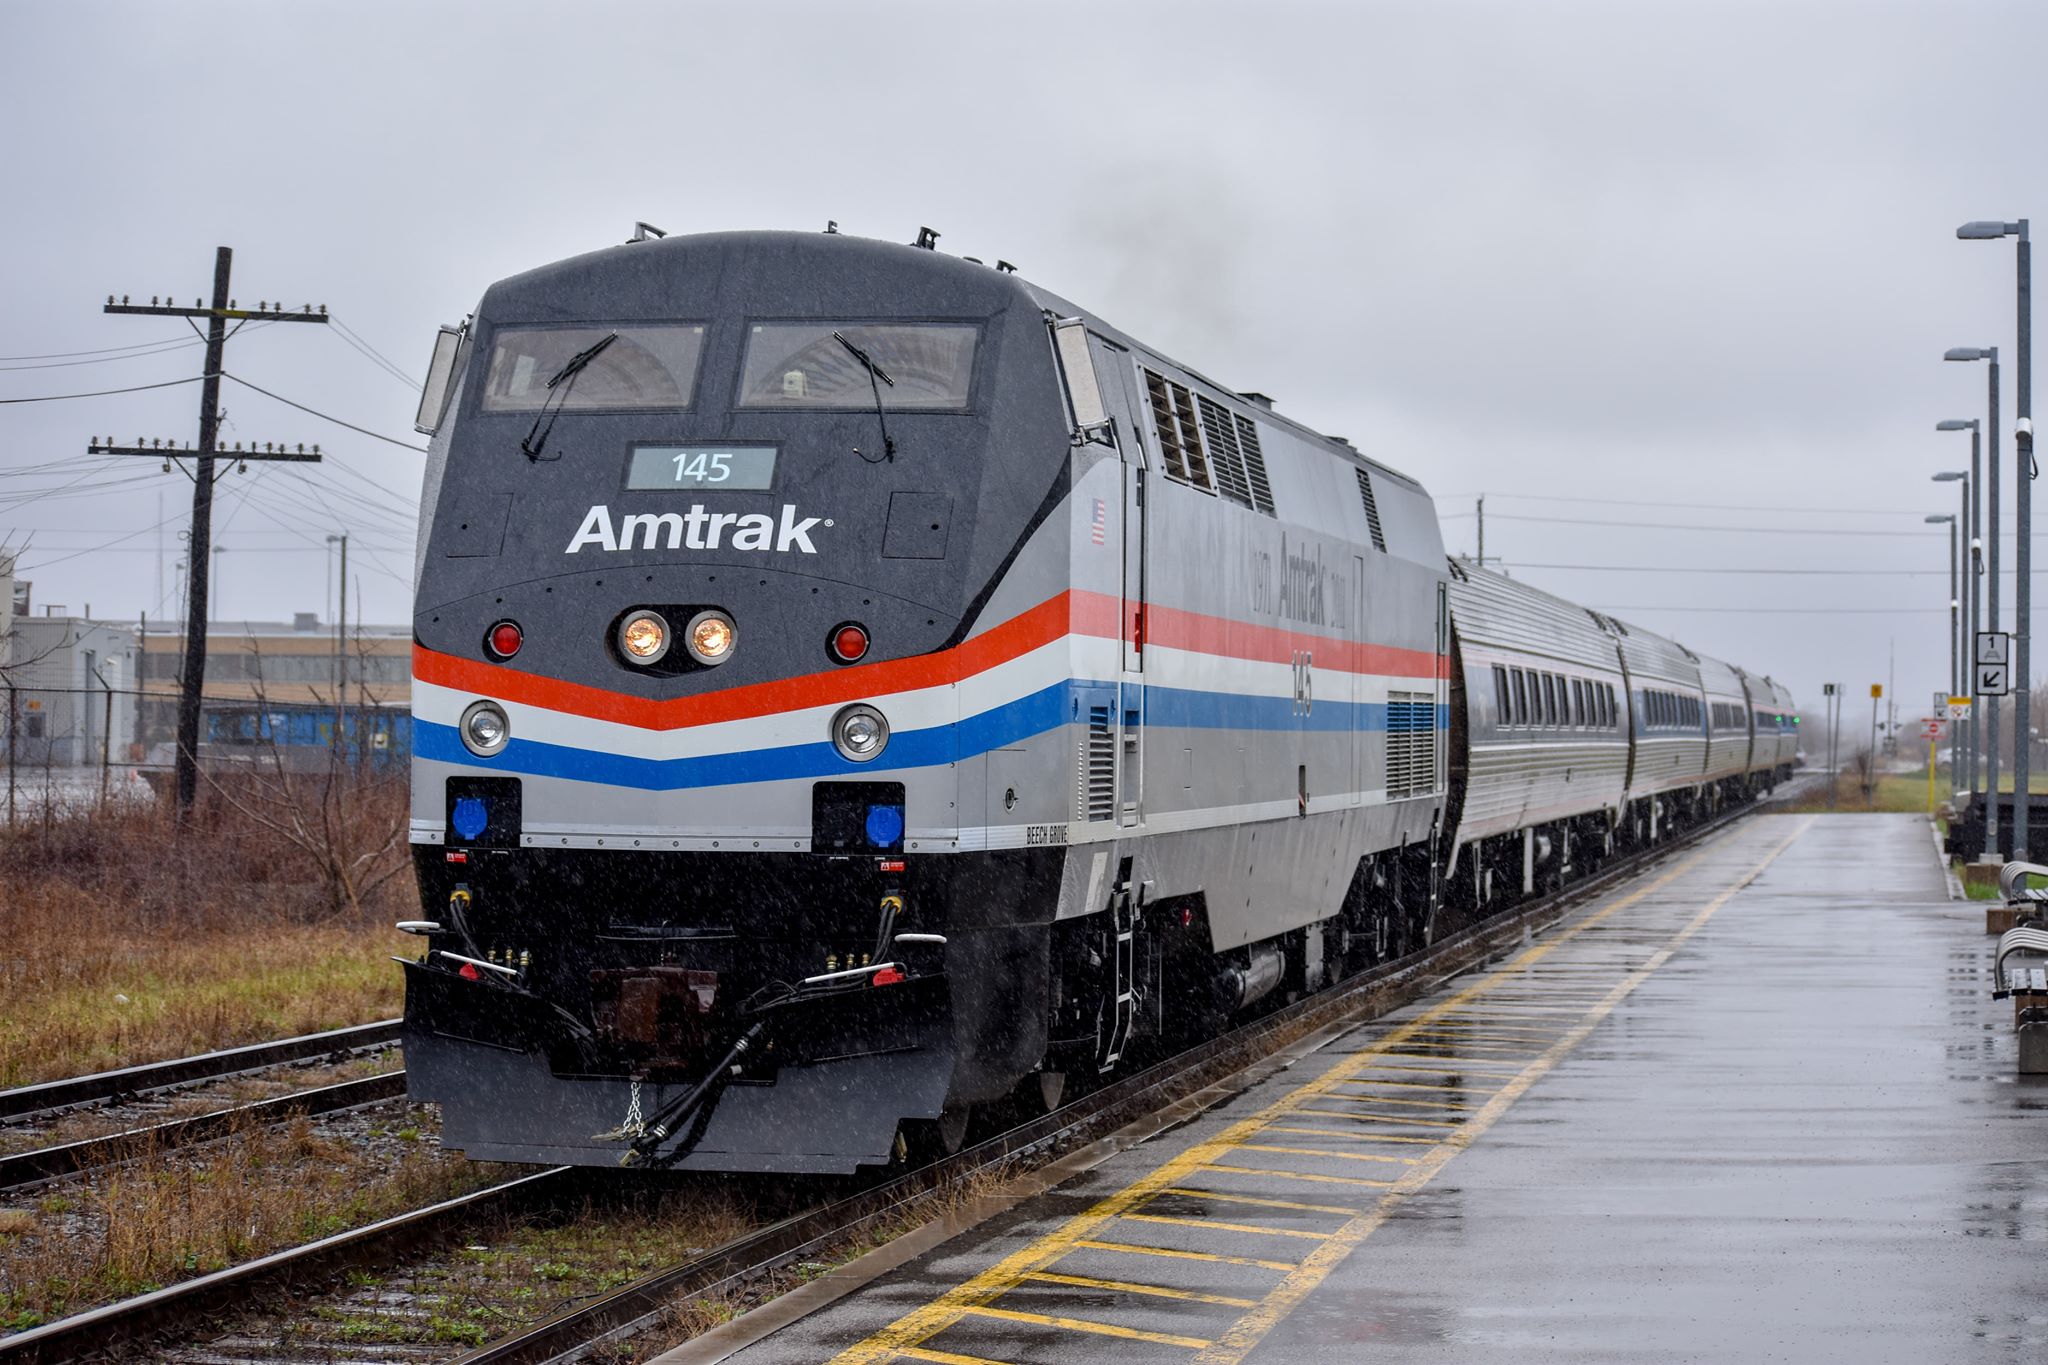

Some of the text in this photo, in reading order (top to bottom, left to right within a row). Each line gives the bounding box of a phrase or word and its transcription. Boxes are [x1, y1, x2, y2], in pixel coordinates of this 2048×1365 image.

[672, 453, 733, 482] 145
[565, 504, 822, 554] Amtrak
[1253, 550, 1272, 615] 1971
[1278, 530, 1326, 626] Amtrak
[1988, 636, 1994, 649] 1
[1291, 649, 1313, 718] 145
[1026, 825, 1067, 845] BEECH GROVE
